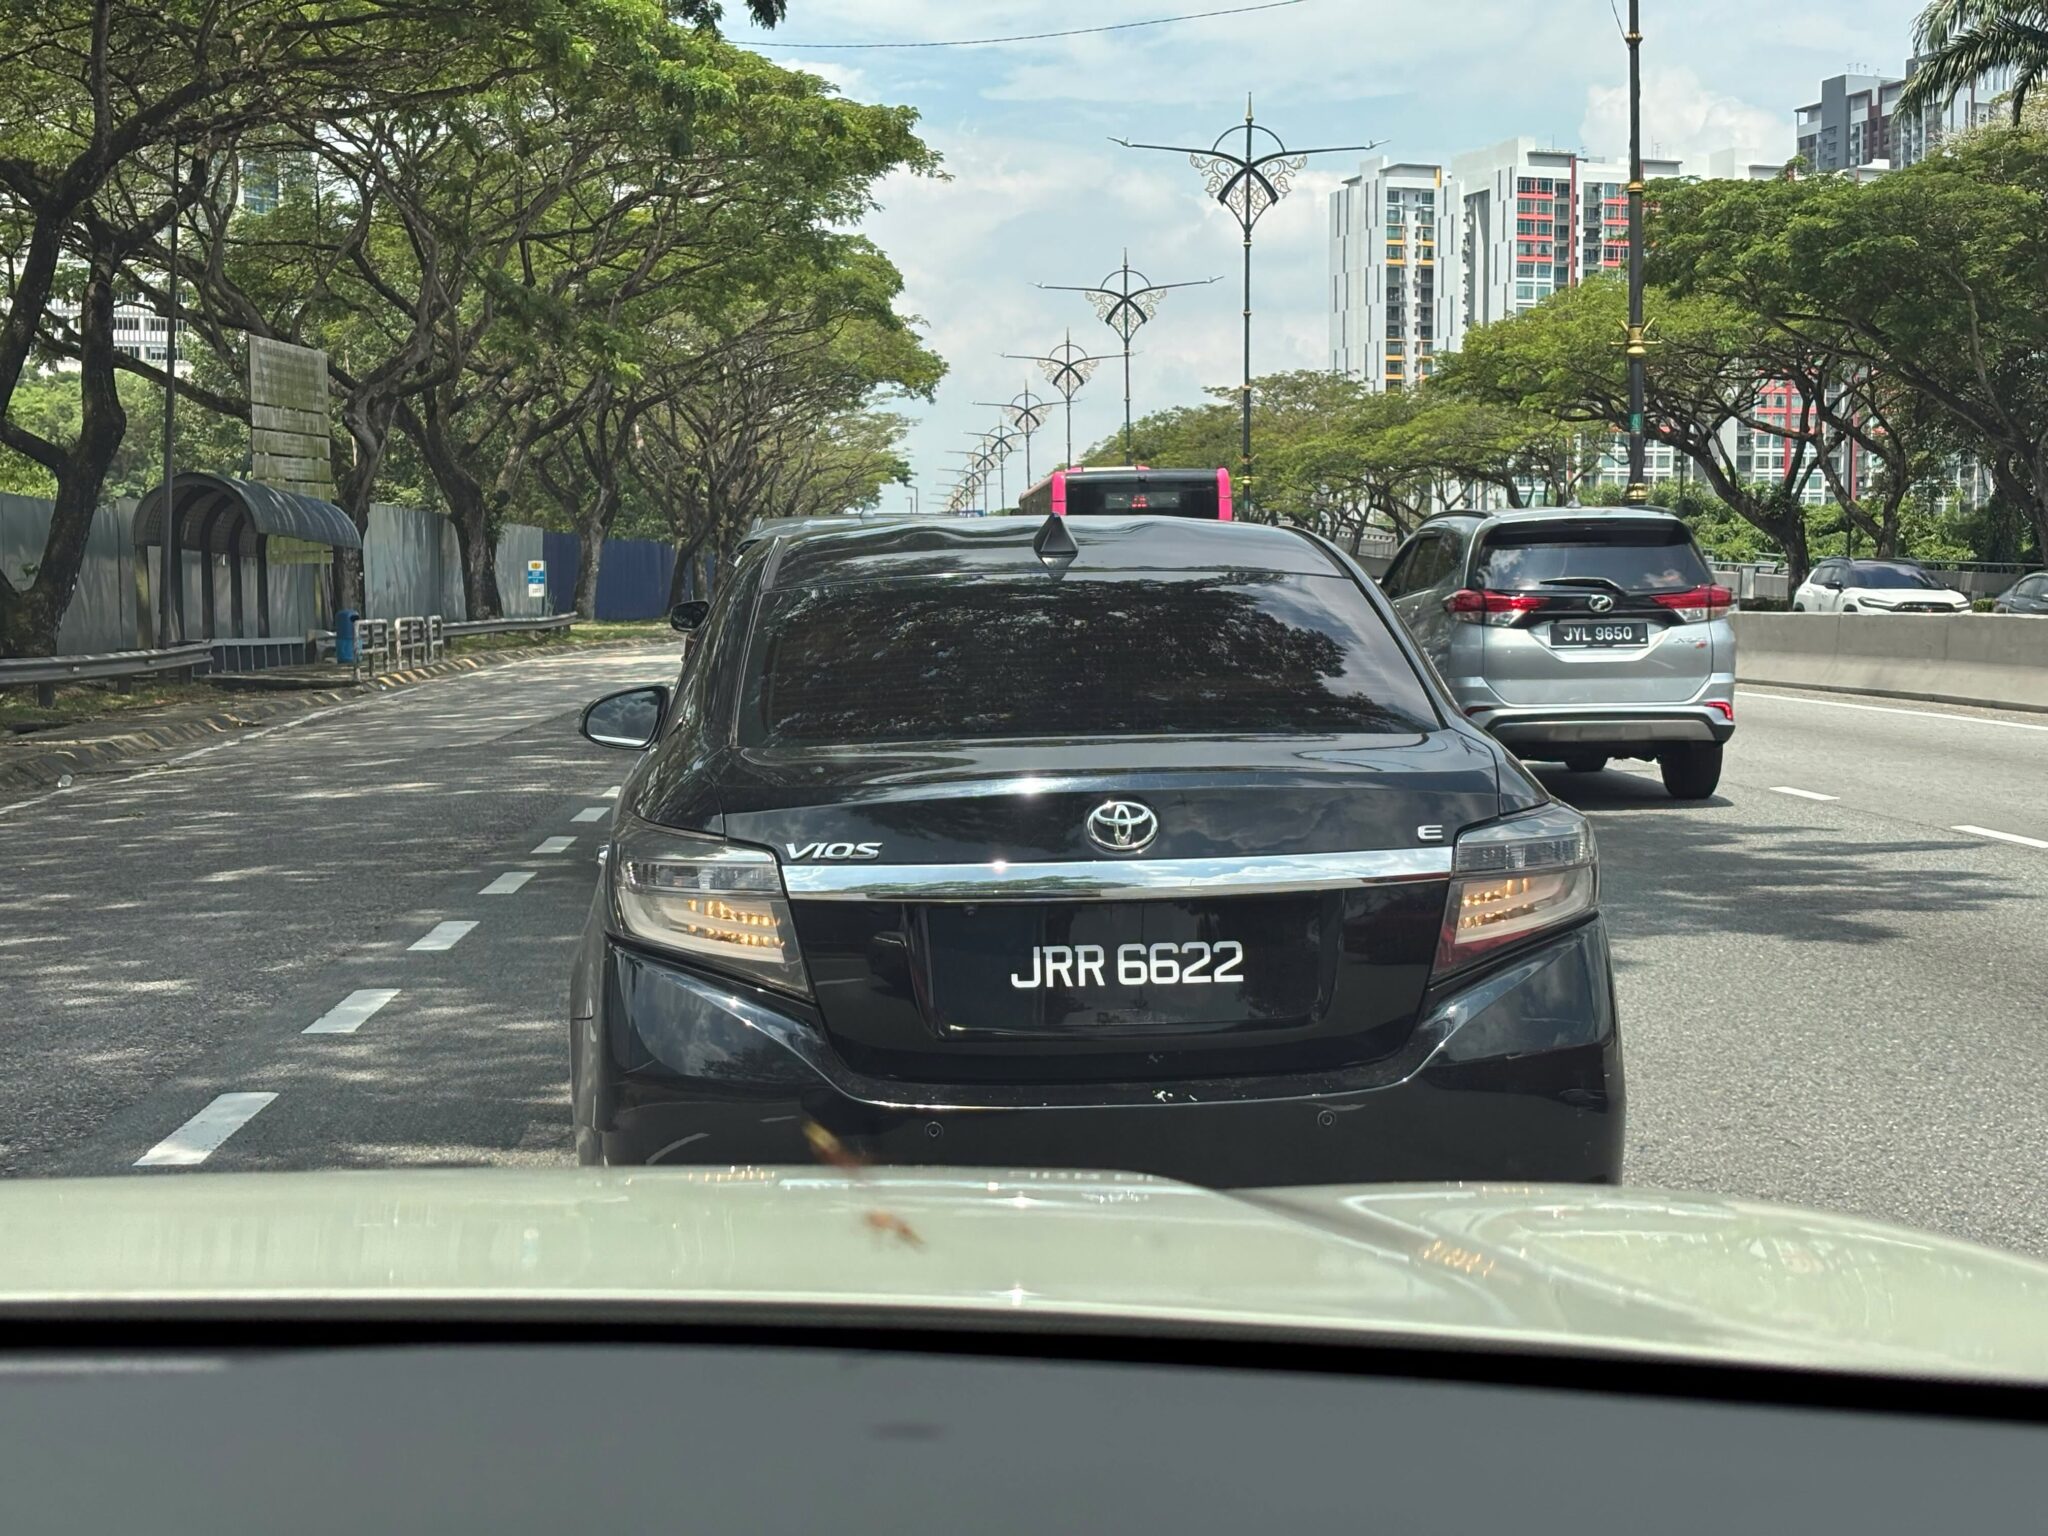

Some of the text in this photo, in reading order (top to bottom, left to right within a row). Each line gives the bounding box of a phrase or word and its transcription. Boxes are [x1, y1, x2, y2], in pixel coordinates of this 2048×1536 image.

[1563, 626, 1633, 642] JYL 9650
[1417, 824, 1444, 840] E
[785, 842, 884, 860] VIOS
[1010, 940, 1244, 989] JRR 6622
